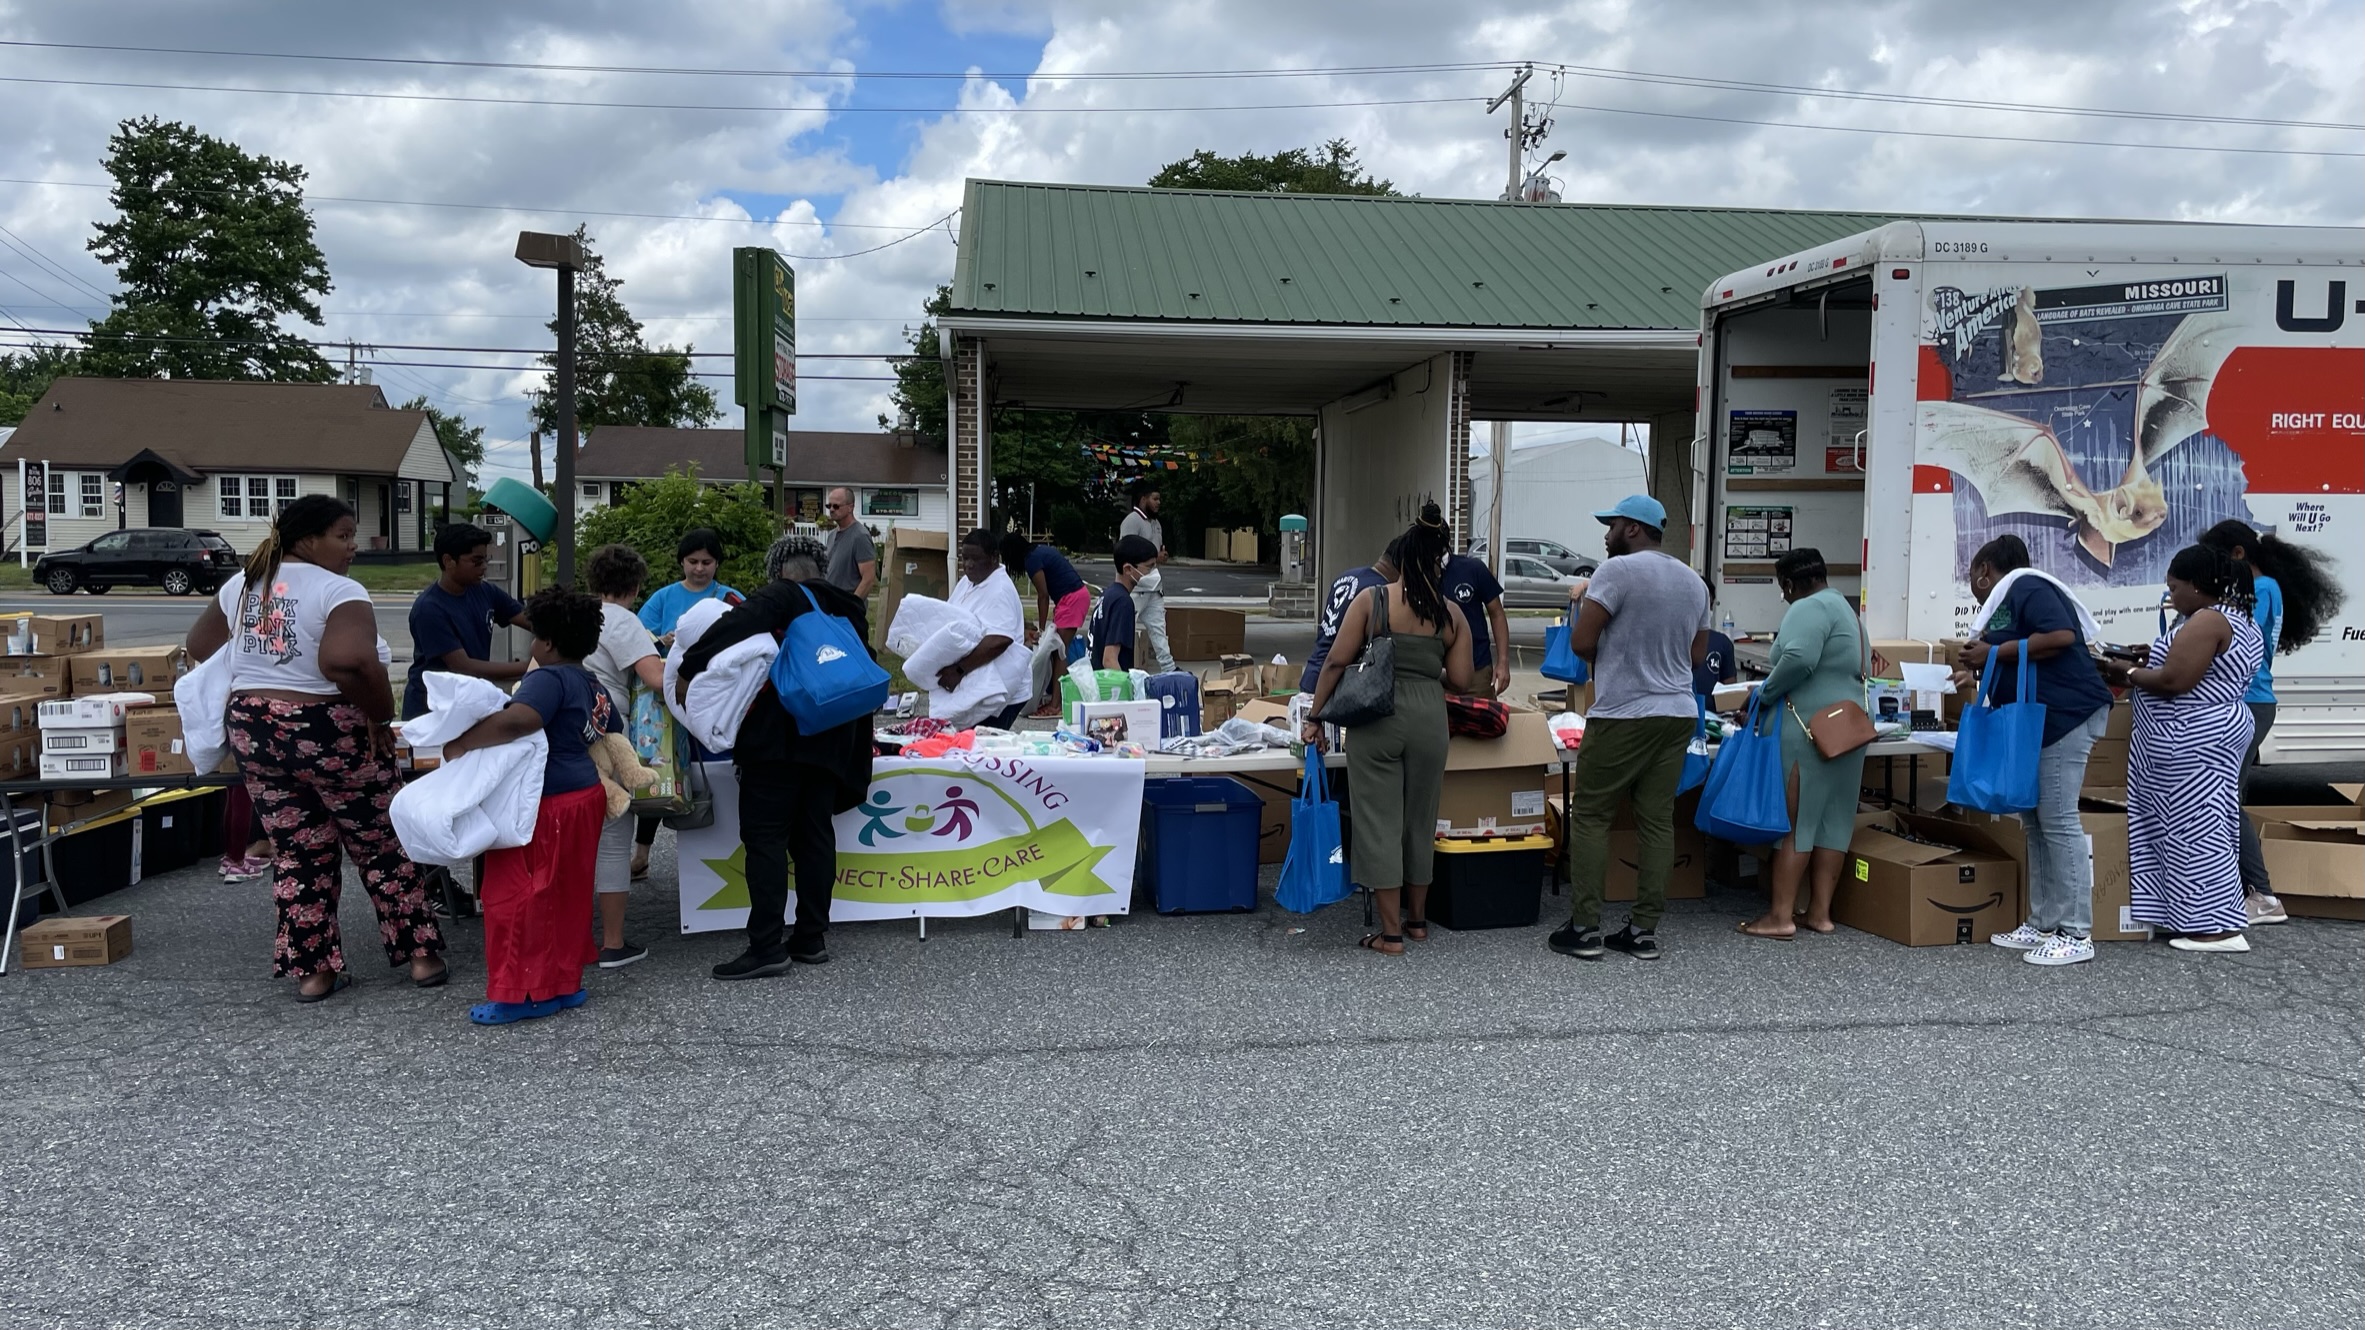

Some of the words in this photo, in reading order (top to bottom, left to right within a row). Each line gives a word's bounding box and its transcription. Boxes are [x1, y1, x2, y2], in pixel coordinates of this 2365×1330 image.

[1935, 242, 1950, 253] DC
[1953, 242, 1977, 253] 3189
[1980, 243, 1988, 253] G
[2125, 279, 2218, 300] MISSOURI
[1934, 291, 1960, 308] #138
[1935, 294, 1988, 335] Venture
[2037, 310, 2069, 321] LANGUAGE
[2069, 309, 2079, 319] OF
[2079, 308, 2095, 318] BATS
[2096, 306, 2126, 316] REVEALED
[2131, 303, 2165, 313] ONONDAGA
[2166, 301, 2181, 311] CAVE
[2182, 300, 2201, 309] STATE
[2202, 298, 2219, 308] PARK
[1955, 294, 2018, 362] America
[2272, 413, 2325, 429] RIGHT
[2332, 413, 2365, 429] EQU
[2296, 501, 2325, 511] Where
[2289, 512, 2306, 522] Will
[2308, 512, 2317, 524] U
[2319, 513, 2331, 522] Go
[1955, 606, 1969, 616] DID
[2093, 608, 2103, 617] and
[2104, 608, 2117, 617] play
[2119, 606, 2131, 614] with
[2103, 617, 2113, 625] and
[964, 757, 1069, 810] SSING
